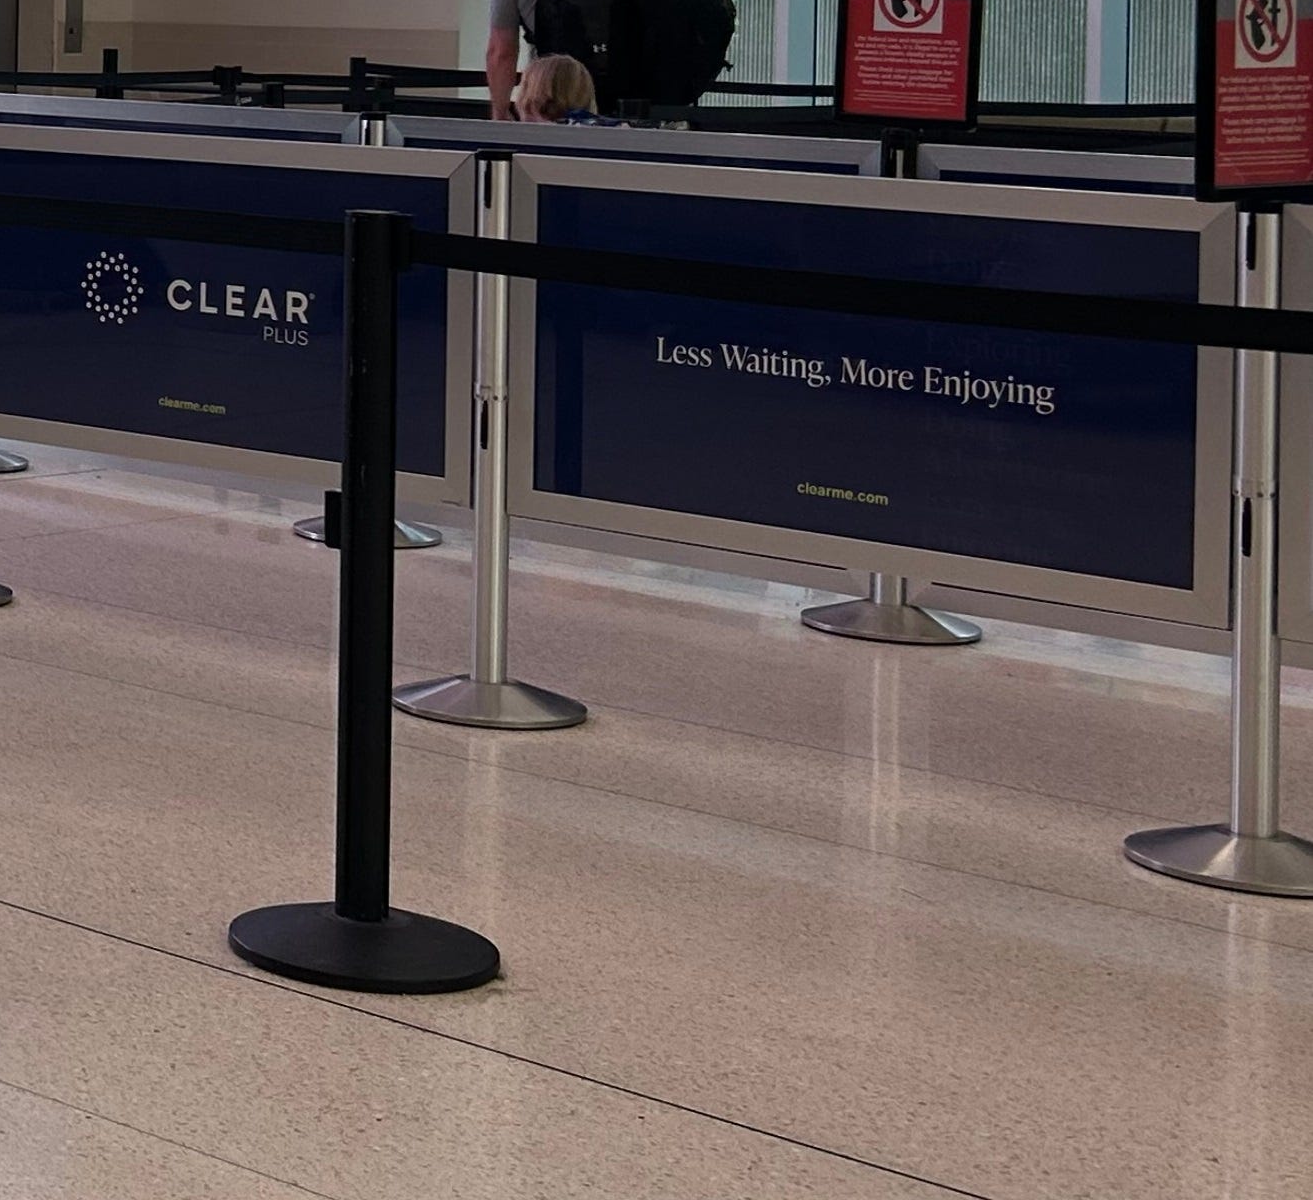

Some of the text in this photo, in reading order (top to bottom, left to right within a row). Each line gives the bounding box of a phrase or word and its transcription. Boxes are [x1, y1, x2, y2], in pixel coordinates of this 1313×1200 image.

[166, 279, 309, 324] CLEAR
[263, 326, 309, 346] PLUS
[655, 336, 1056, 415] Less Waiting, More Enjoying
[158, 396, 226, 415] clearme.com
[796, 481, 889, 506] clearme.com
